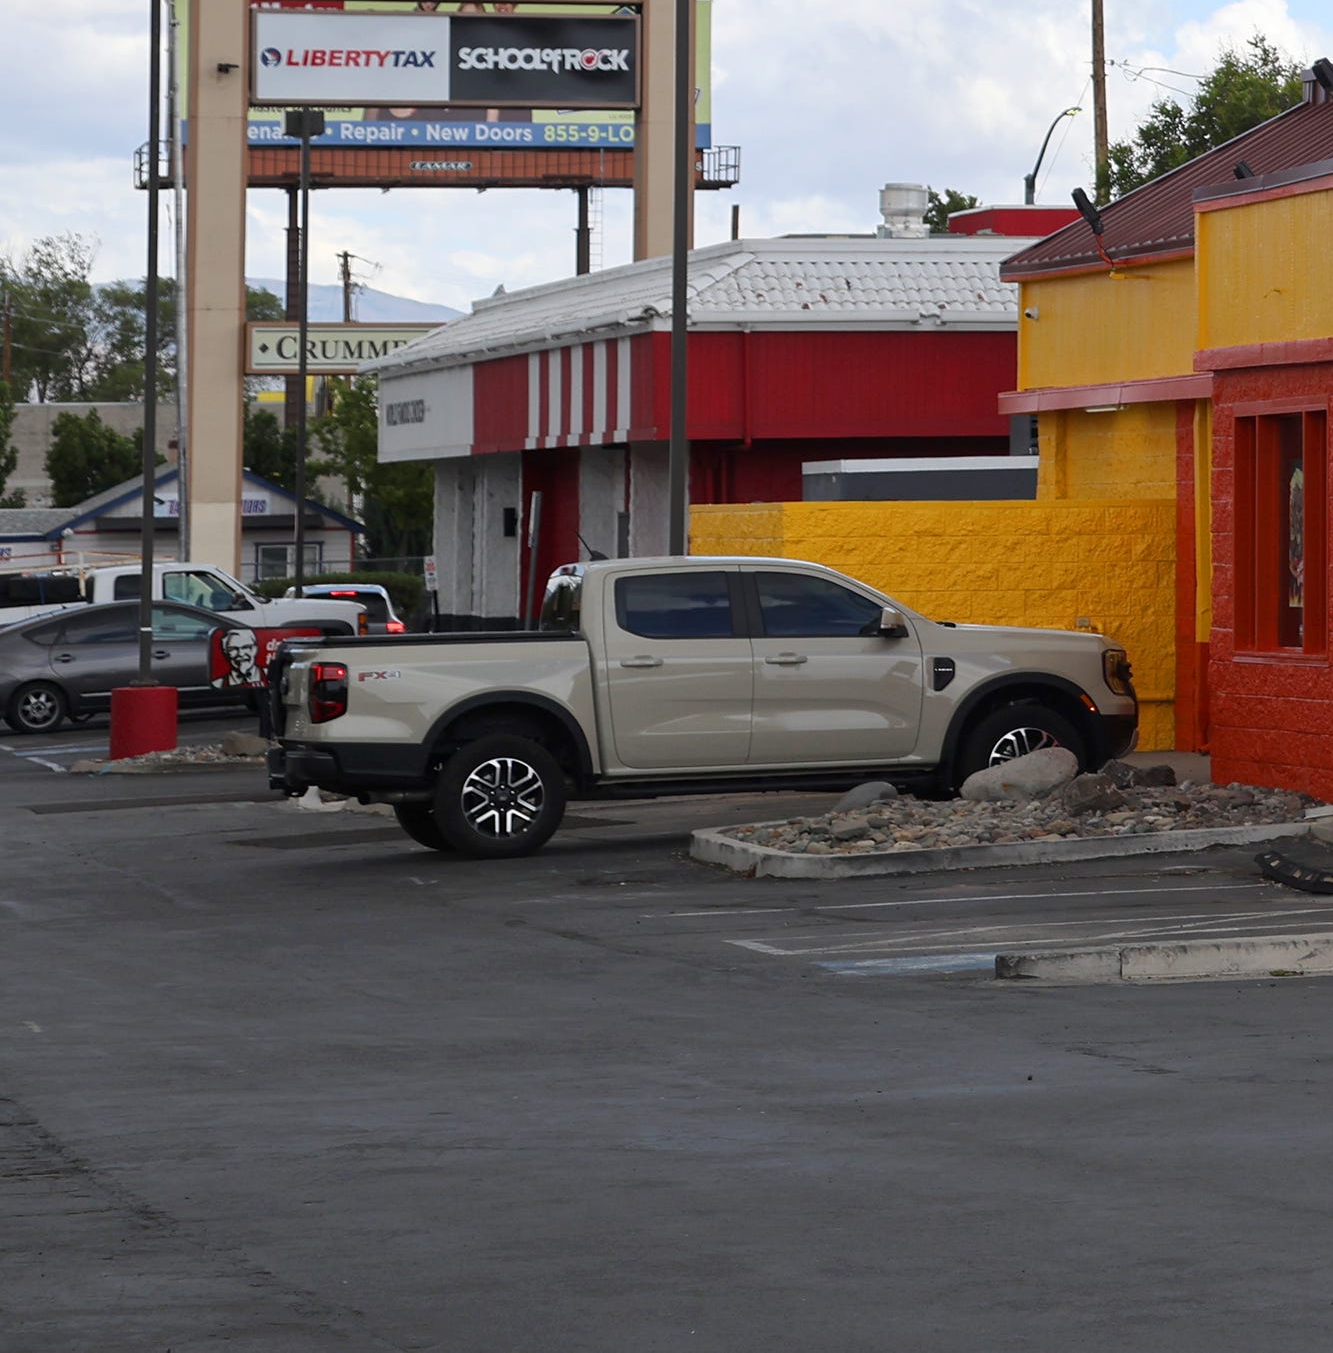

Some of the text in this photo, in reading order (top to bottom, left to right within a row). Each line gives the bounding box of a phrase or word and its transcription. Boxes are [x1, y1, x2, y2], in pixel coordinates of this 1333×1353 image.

[341, 123, 404, 143] Repair
[426, 124, 475, 141] New
[480, 124, 533, 142] Doors
